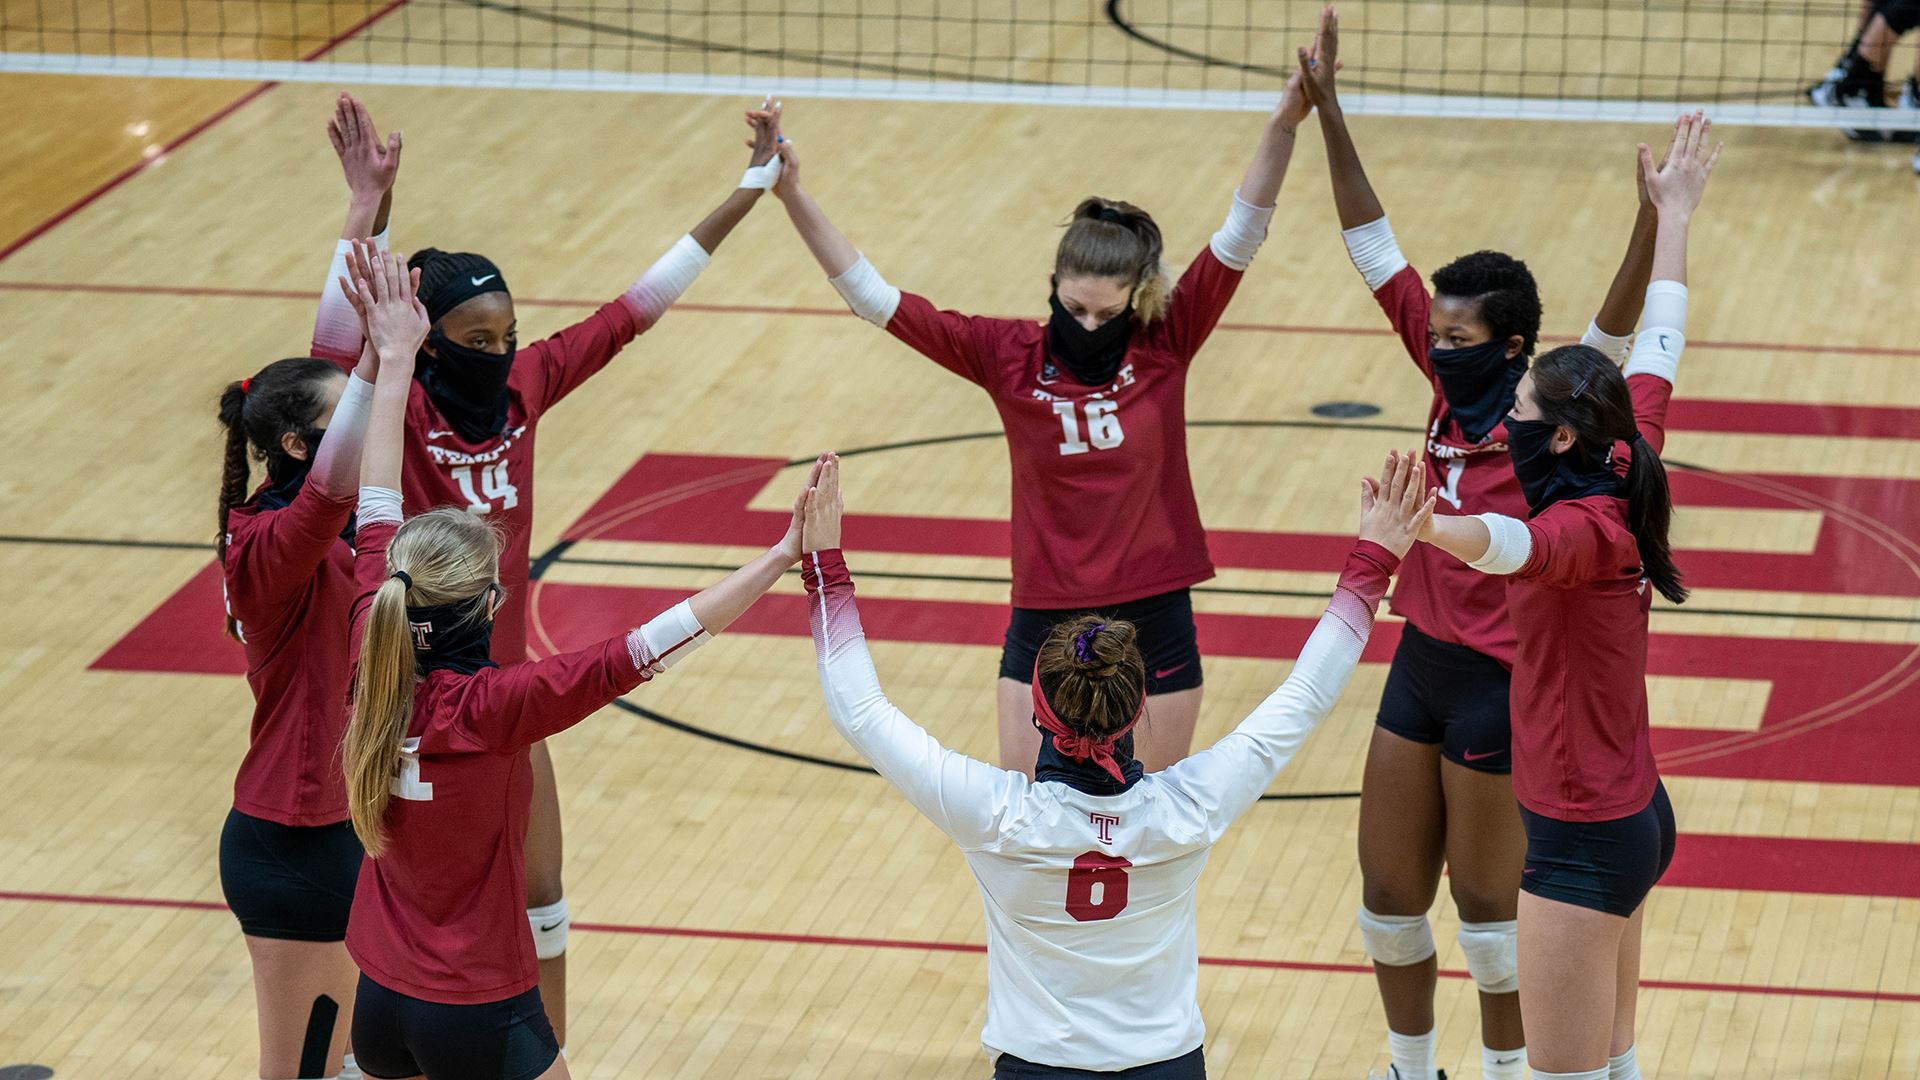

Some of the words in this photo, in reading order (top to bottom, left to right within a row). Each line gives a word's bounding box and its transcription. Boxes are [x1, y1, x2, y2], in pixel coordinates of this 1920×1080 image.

[1052, 400, 1125, 456] 16
[451, 459, 518, 514] 14
[410, 621, 433, 650] T
[1089, 812, 1120, 846] T
[1065, 850, 1134, 922] 6
